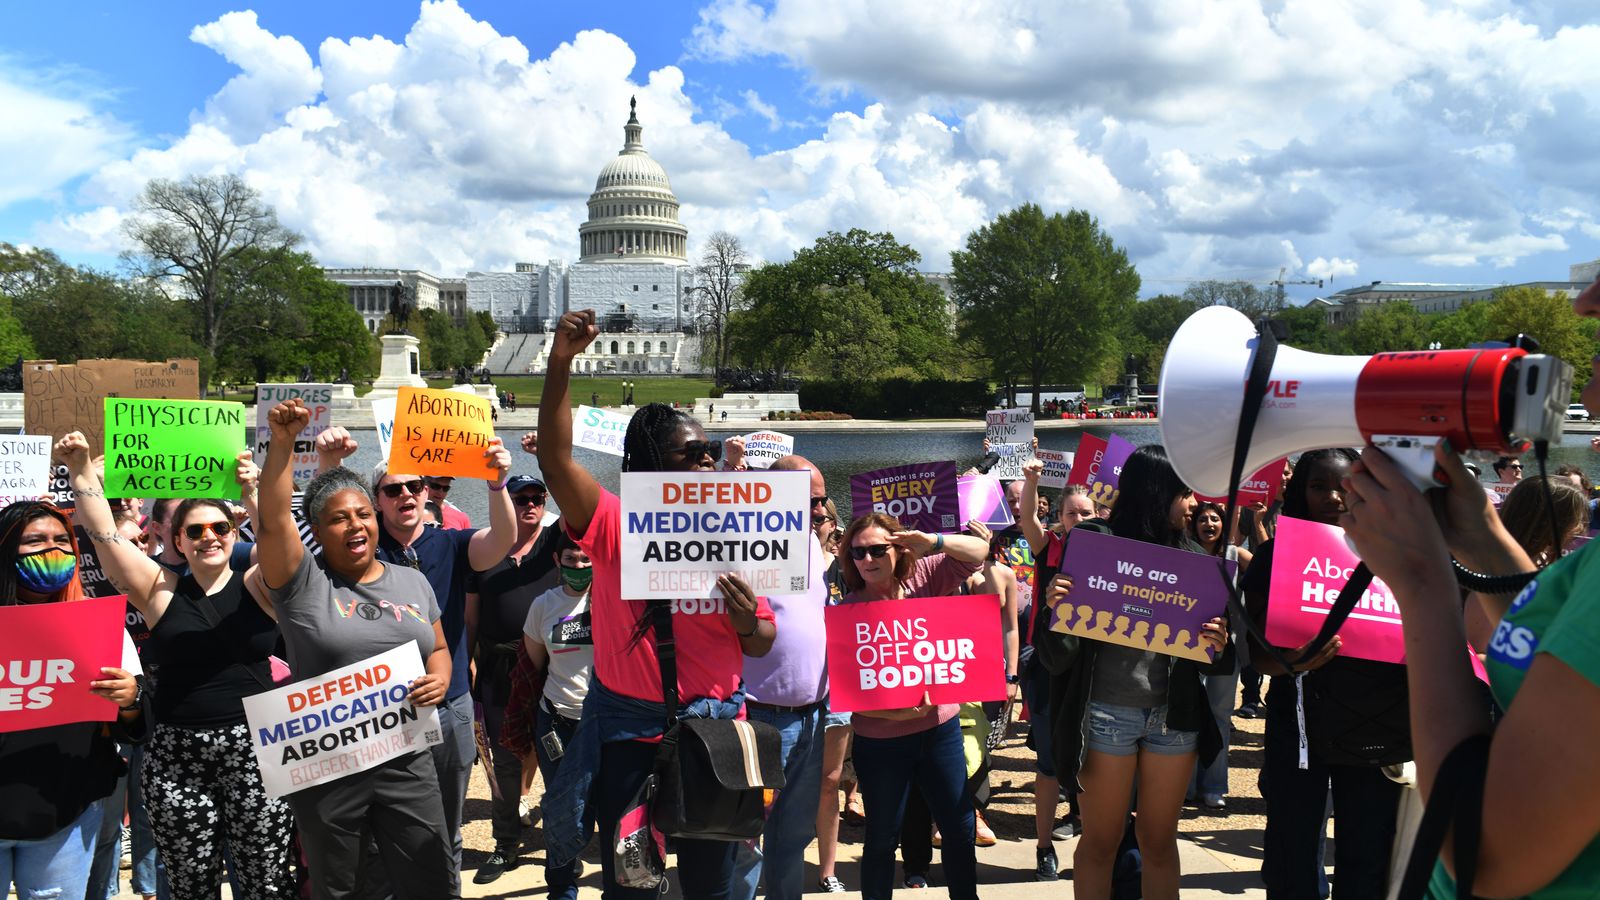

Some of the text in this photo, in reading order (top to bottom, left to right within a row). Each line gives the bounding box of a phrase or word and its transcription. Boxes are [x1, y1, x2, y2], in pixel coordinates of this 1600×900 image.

[29, 368, 94, 396] BANS
[261, 388, 331, 403] JUDGES
[28, 396, 99, 424] OFF MY
[114, 402, 241, 428] PHYSICIAN
[407, 393, 486, 423] ABORTION
[987, 412, 1031, 424] STOP LAWS
[112, 433, 150, 450] FOR
[406, 426, 422, 441] IS
[432, 427, 491, 448] HEALTH
[751, 433, 783, 443] DEFEND
[986, 425, 1016, 436] GIVING
[114, 453, 225, 473] ABORTION
[410, 445, 456, 464] CARE
[995, 455, 1027, 469] OMEN'S
[1037, 451, 1063, 461] EFEND
[122, 473, 213, 492] ACCESS
[870, 475, 906, 486] FREEDOM
[919, 471, 936, 479] FOR
[1041, 469, 1066, 478] RTION
[1245, 480, 1270, 489] are.
[662, 482, 772, 505] DEFEND
[871, 479, 936, 503] EVERY
[873, 495, 937, 517] BODY
[628, 510, 803, 534] MEDICATION
[642, 539, 789, 563] ABORTION
[648, 570, 709, 592] BIGGER
[757, 568, 782, 590] ROE
[1116, 560, 1178, 584] We are
[1088, 575, 1198, 612] the majority
[1301, 580, 1401, 614] Helth
[855, 618, 929, 644] BANS
[856, 638, 976, 667] OFF OUR
[0, 658, 75, 686] UR
[859, 661, 966, 690] BODIES
[286, 664, 392, 714] DEFEND
[281, 705, 419, 766] ABORTION
[290, 729, 416, 787] BIGGER THAN ROE
